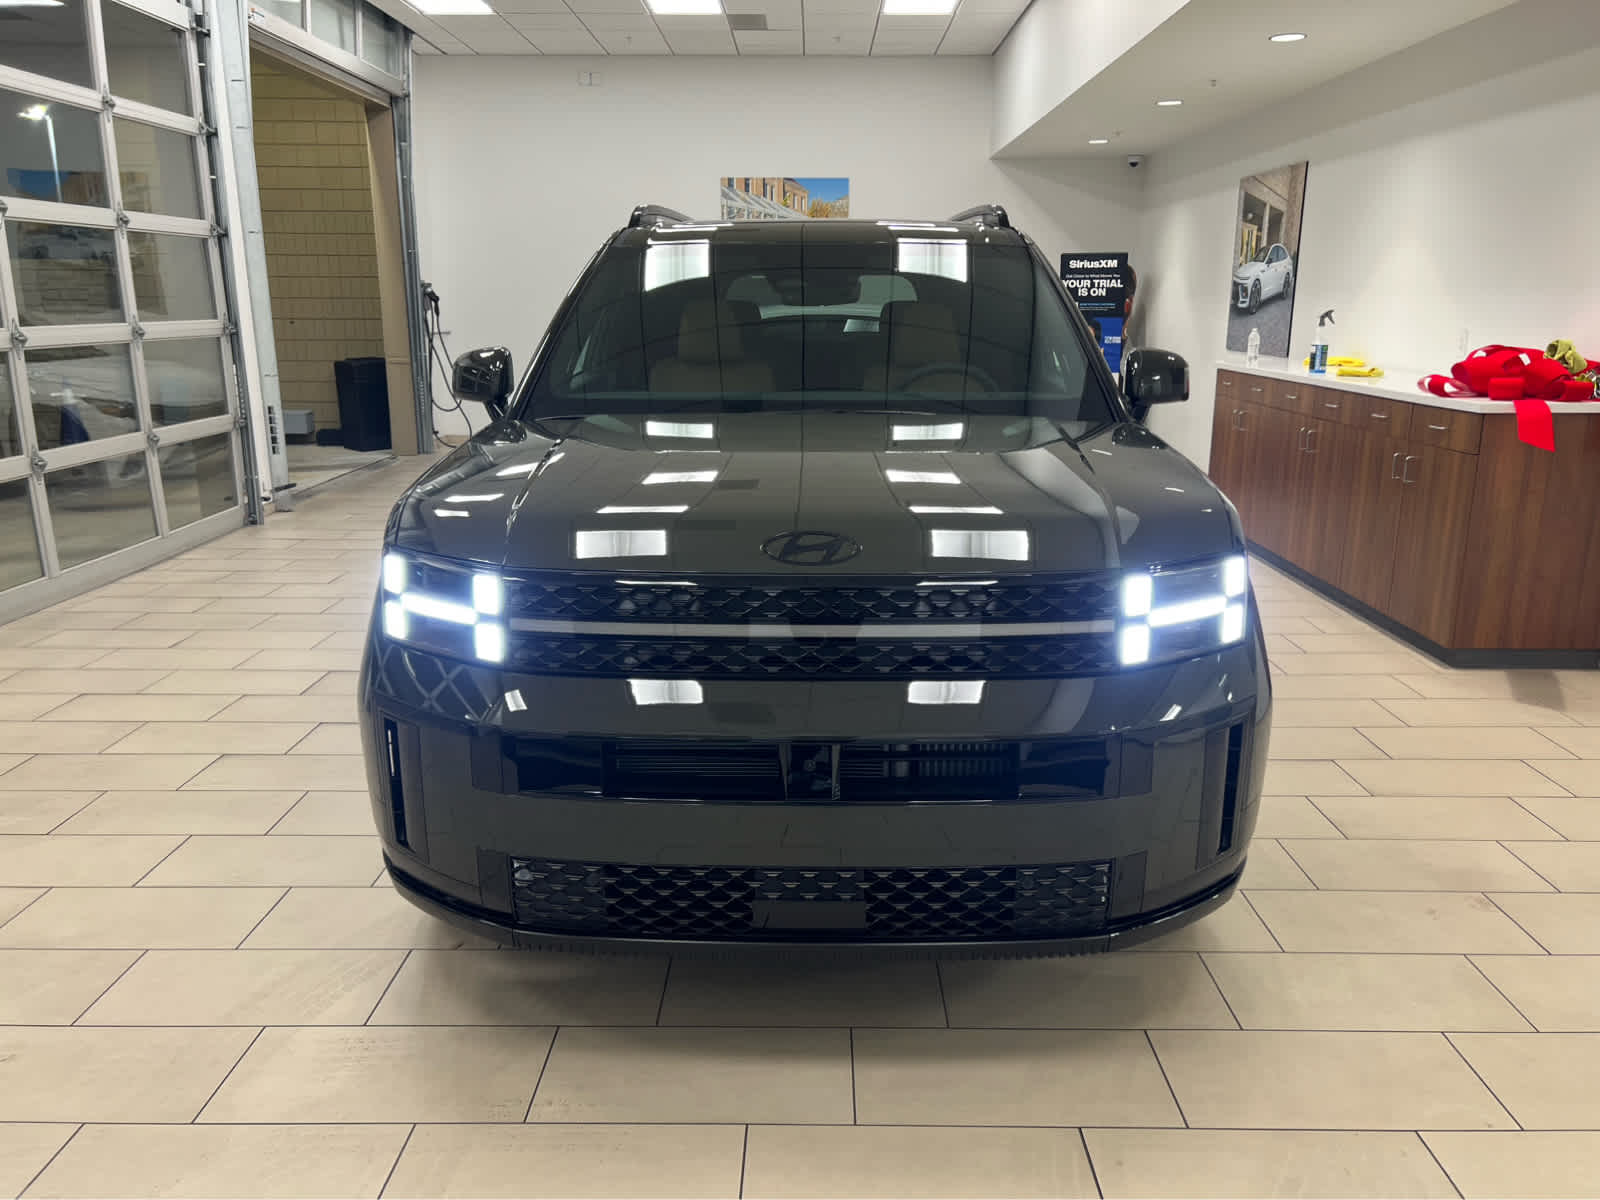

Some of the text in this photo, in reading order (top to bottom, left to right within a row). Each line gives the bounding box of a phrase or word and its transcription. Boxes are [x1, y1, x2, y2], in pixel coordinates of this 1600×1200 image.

[1069, 260, 1118, 268] SiriusXM
[1062, 280, 1124, 288] YOUR TRIAL
[1078, 288, 1106, 296] IS ON
